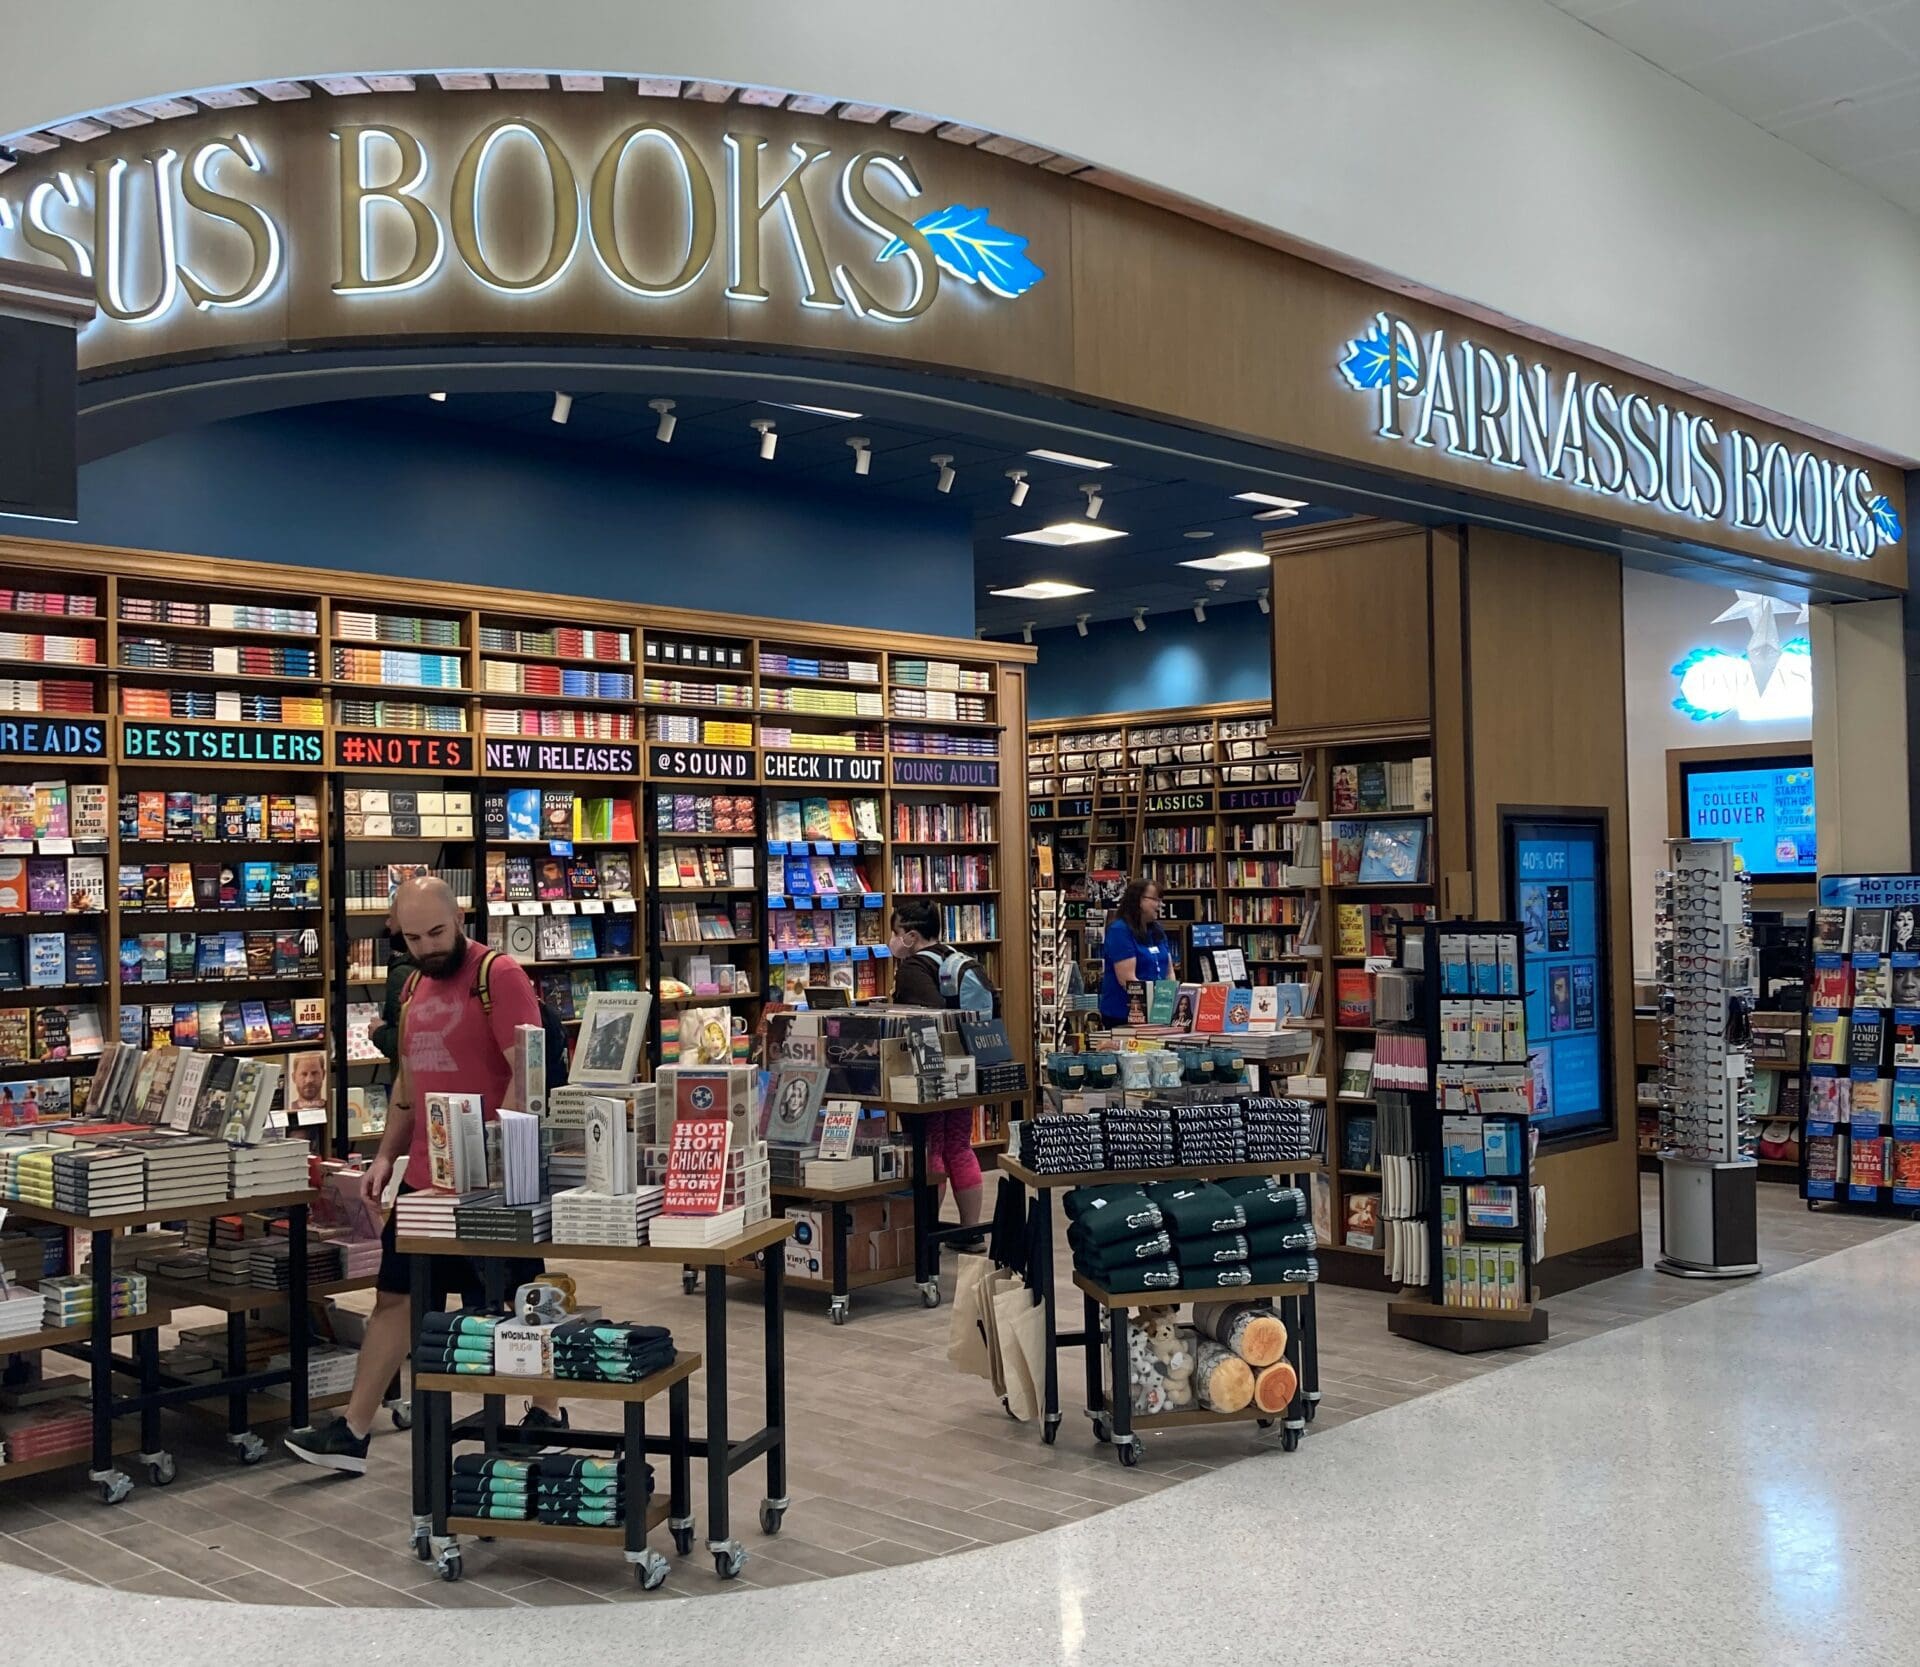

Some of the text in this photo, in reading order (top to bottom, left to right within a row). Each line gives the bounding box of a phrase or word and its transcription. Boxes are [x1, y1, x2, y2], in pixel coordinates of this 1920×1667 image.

[0, 117, 940, 323] SUS BOOKS
[1375, 312, 1879, 560] PARNASSUS BOOKS
[0, 722, 102, 754] READS
[125, 728, 322, 761] BESTSELLERS
[342, 737, 461, 766] #NOTES
[486, 744, 632, 772] NEW RELEASES
[765, 755, 882, 780] CHECK IT OUT
[893, 760, 996, 785] YOUNG ADULT
[1704, 792, 1758, 806] COLLEEN
[484, 813, 504, 823] 100
[1698, 807, 1765, 825] HOOVER
[1546, 852, 1565, 870] OFF
[145, 877, 167, 897] 21
[1860, 880, 1920, 890] HOT OFF
[540, 888, 564, 898] SAM
[1855, 893, 1882, 904] THE
[598, 998, 640, 1006] NASHVILLE
[974, 1034, 1004, 1048] GUITAR
[1852, 1033, 1879, 1042] FORD
[769, 1042, 816, 1059] CASH
[673, 1137, 723, 1150] HOT
[671, 1151, 721, 1170] CHICKEN
[1851, 1162, 1882, 1171] VERSE
[668, 1179, 719, 1189] STORY
[666, 1197, 716, 1206] MARTIN
[787, 1253, 807, 1265] Vinyl
[501, 1331, 540, 1340] WOODLAND
